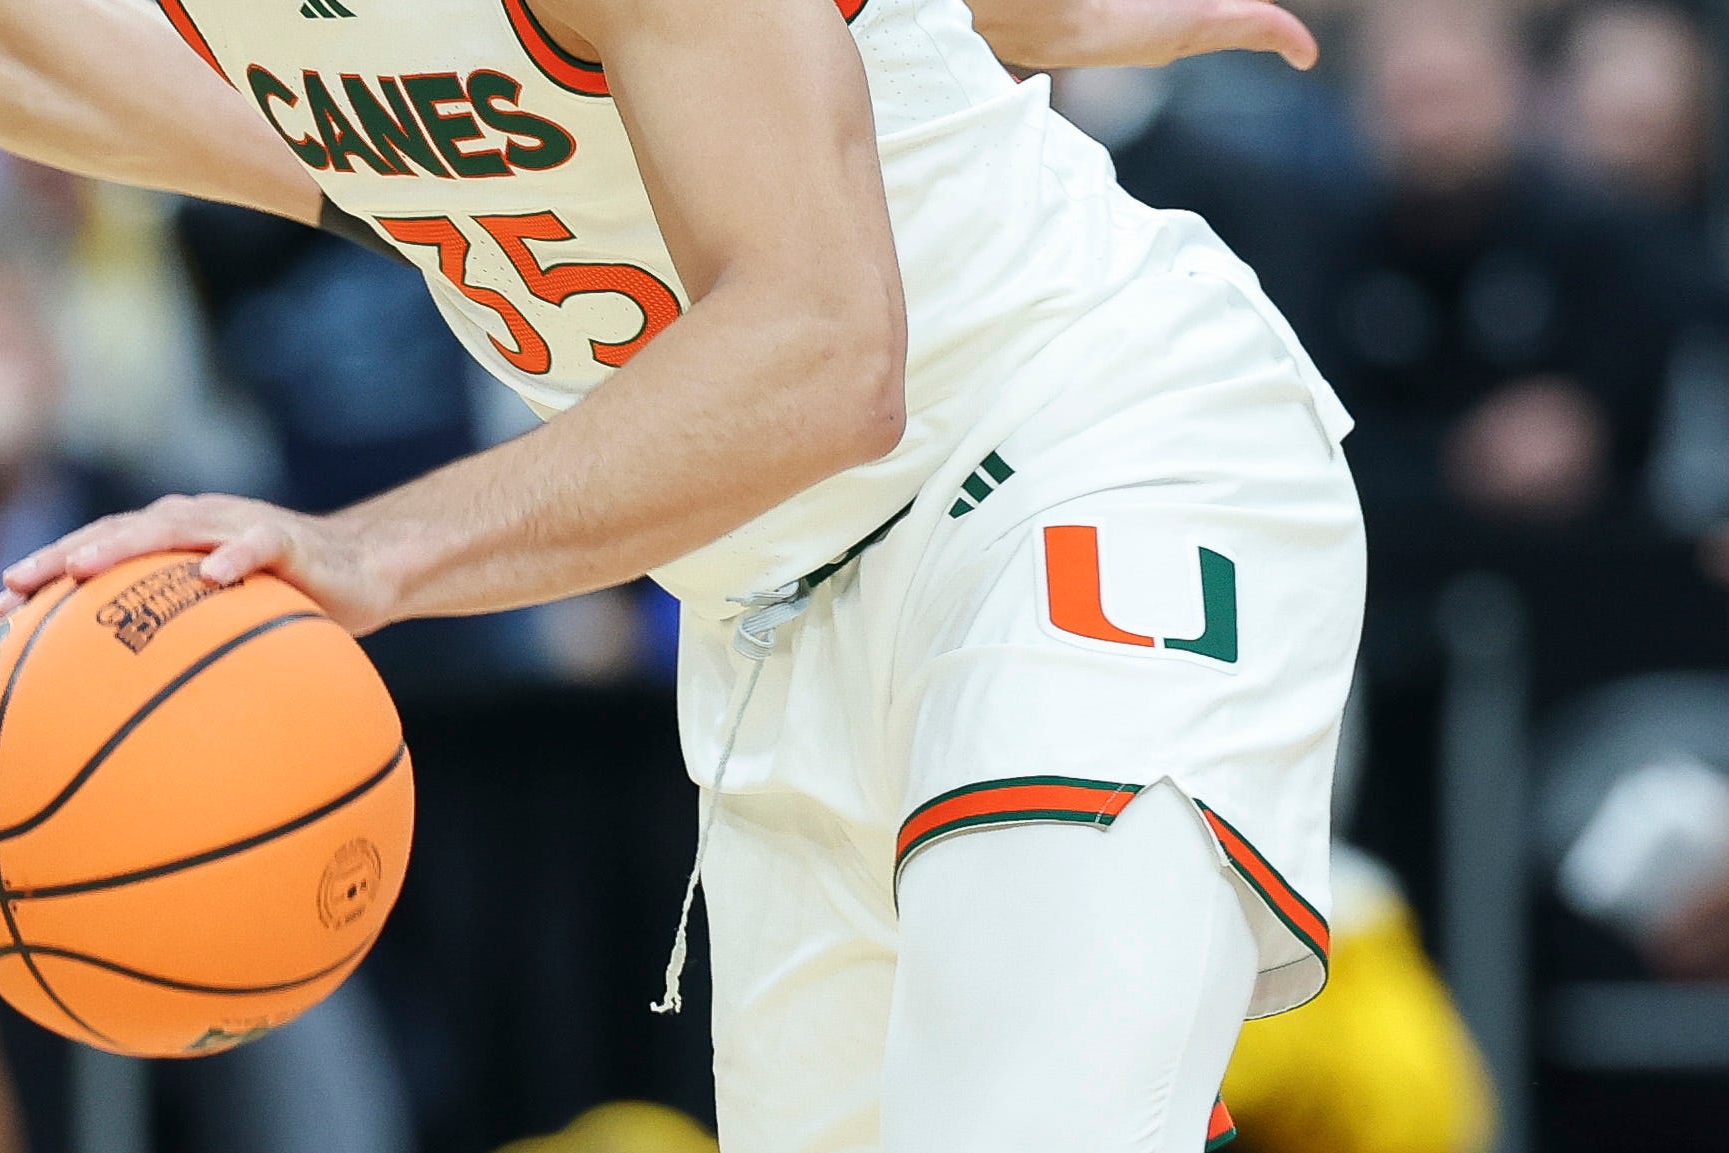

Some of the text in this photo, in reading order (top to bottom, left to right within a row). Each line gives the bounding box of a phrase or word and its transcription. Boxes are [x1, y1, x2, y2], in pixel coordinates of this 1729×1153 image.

[247, 63, 576, 180] CANES
[372, 210, 681, 375] 35
[1043, 525, 1238, 663] U
